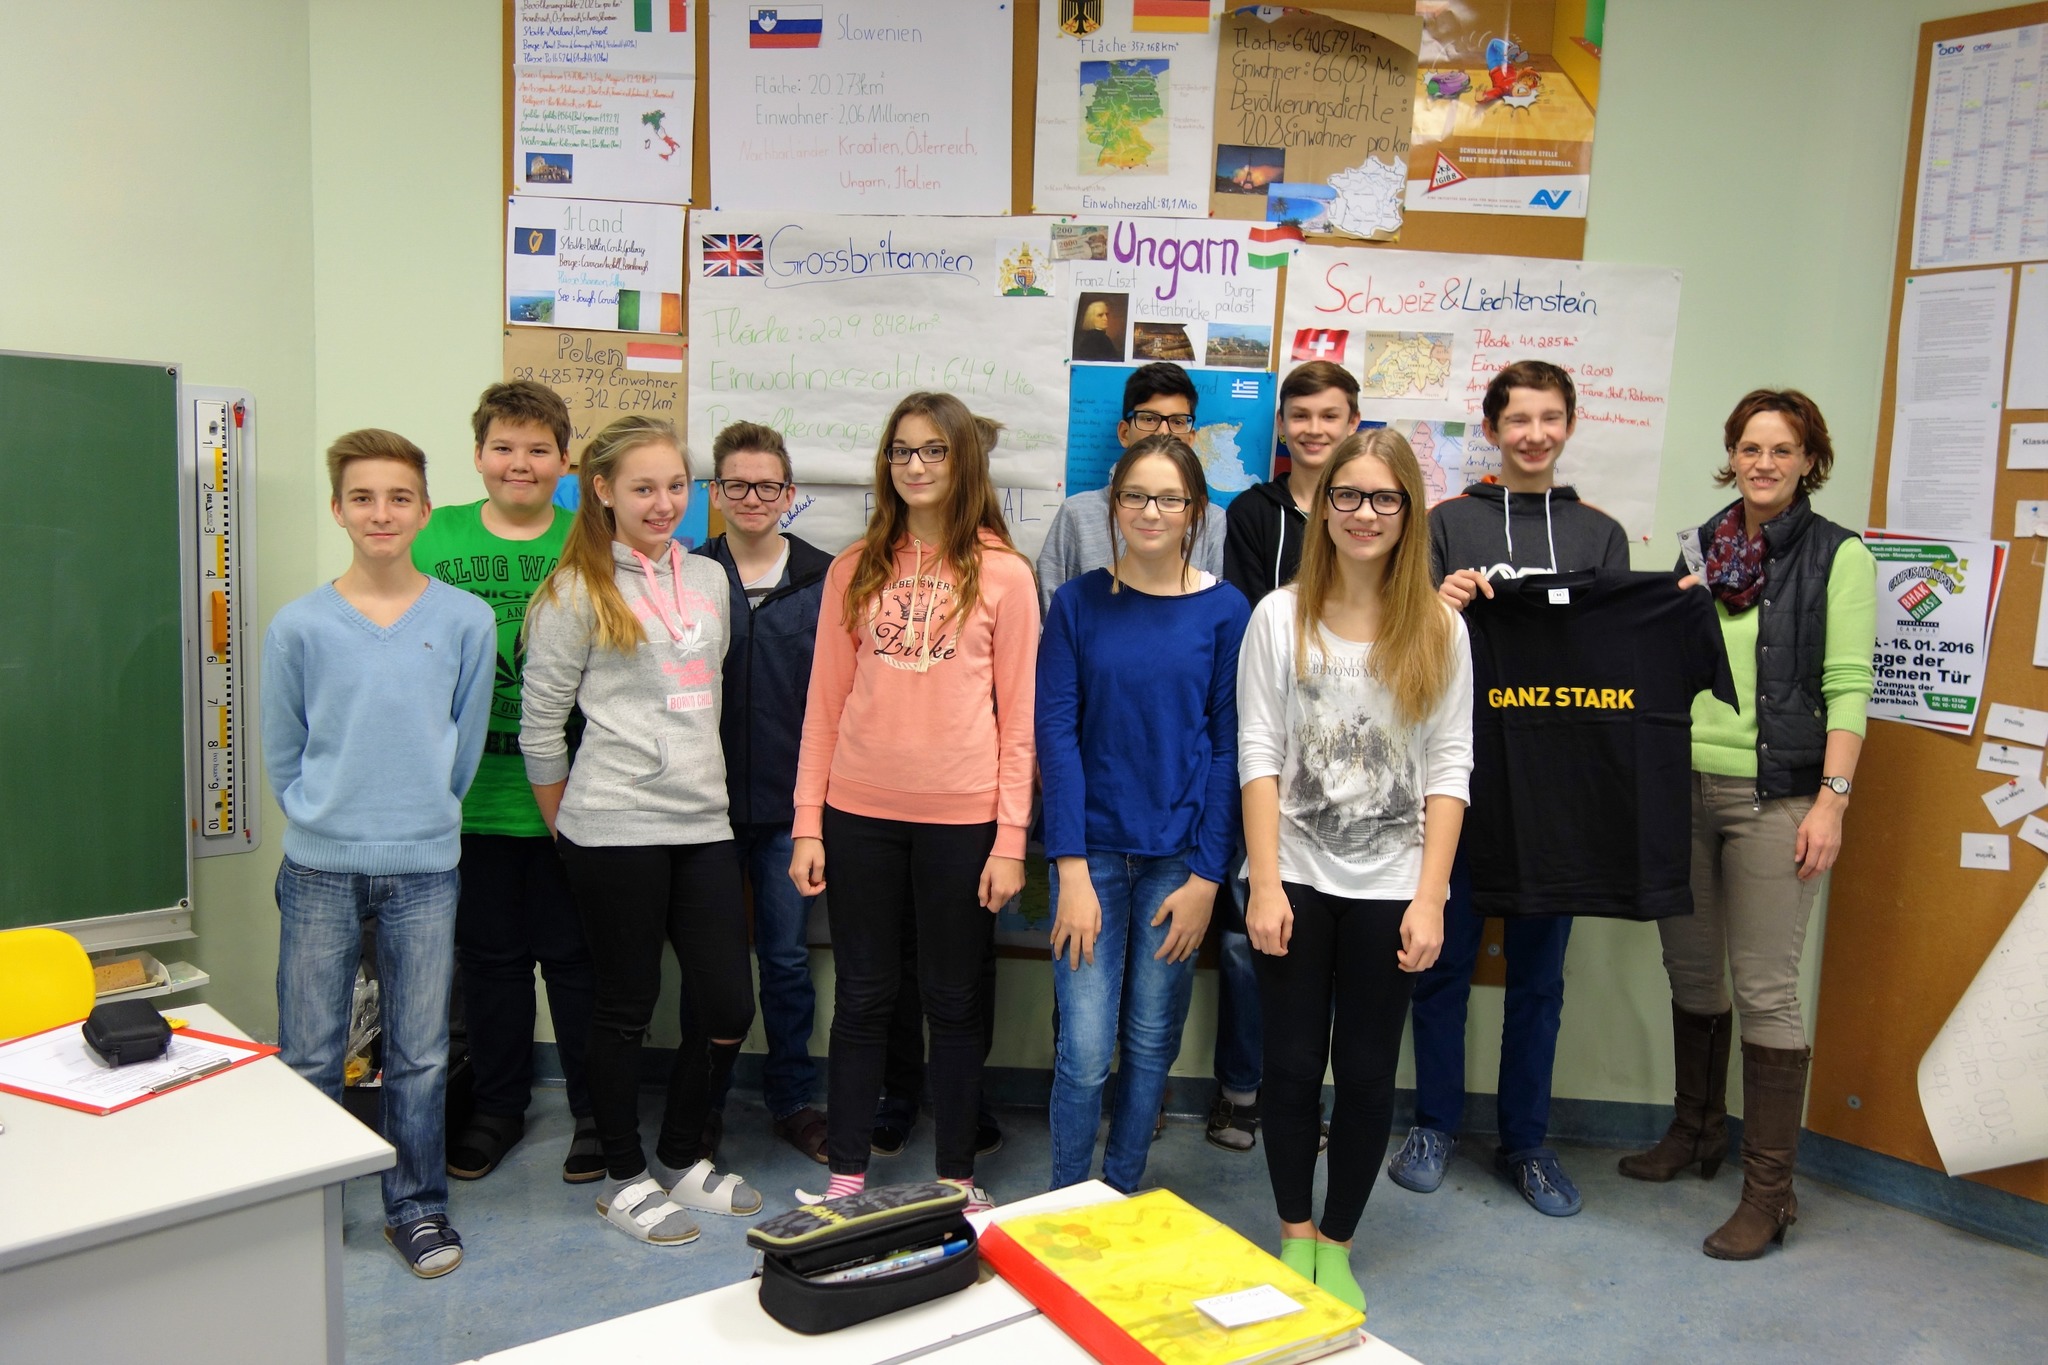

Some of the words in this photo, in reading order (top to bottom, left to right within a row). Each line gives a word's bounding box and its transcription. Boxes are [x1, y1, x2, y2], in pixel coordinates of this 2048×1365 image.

[837, 13, 923, 43] Slowenien
[1232, 52, 1310, 80] Einwohner:
[755, 74, 802, 95] Fläche:
[755, 103, 834, 125] Einwohner:
[868, 103, 930, 124] Millionen
[838, 132, 903, 156] Kroatien,
[905, 126, 978, 156] Österreich,
[839, 171, 891, 195] Ungarn,
[894, 164, 941, 190] Italien
[563, 205, 624, 233] Irland
[768, 224, 974, 277] Grossbritannien
[1113, 221, 1239, 300] Ungarn
[1075, 271, 1104, 288] Franz
[1107, 269, 1137, 288] Liszt
[1315, 262, 1435, 315] Schweiz
[1439, 277, 1461, 311] &
[1462, 276, 1598, 316] Liechtenstein
[1224, 281, 1262, 304] Burg-
[1135, 298, 1210, 322] Kettenbrücke
[1215, 298, 1256, 319] palast
[558, 333, 623, 366] Polen
[609, 367, 678, 389] Einwohner
[710, 353, 936, 392] Einwohnerzahl:
[1003, 371, 1035, 396] Mio
[435, 555, 509, 585] KLUG
[1901, 583, 1929, 609] BHAK
[1911, 598, 1935, 619] BHAS
[1892, 638, 1911, 650] 16.
[1915, 639, 1935, 651] 01.
[1939, 641, 1974, 654] 2016
[206, 655, 218, 663] 6
[1873, 653, 1906, 667] age
[1913, 654, 1945, 667] der
[1872, 664, 1931, 681] ffenen
[1937, 669, 1972, 684] Tür
[1872, 688, 1917, 697] AK/BHAS
[1876, 680, 1915, 691] Campus
[1488, 687, 1550, 709] GANZ
[1555, 687, 1636, 710] STARK
[207, 740, 219, 748] 8
[207, 782, 219, 790] 9
[208, 818, 219, 830] 10
